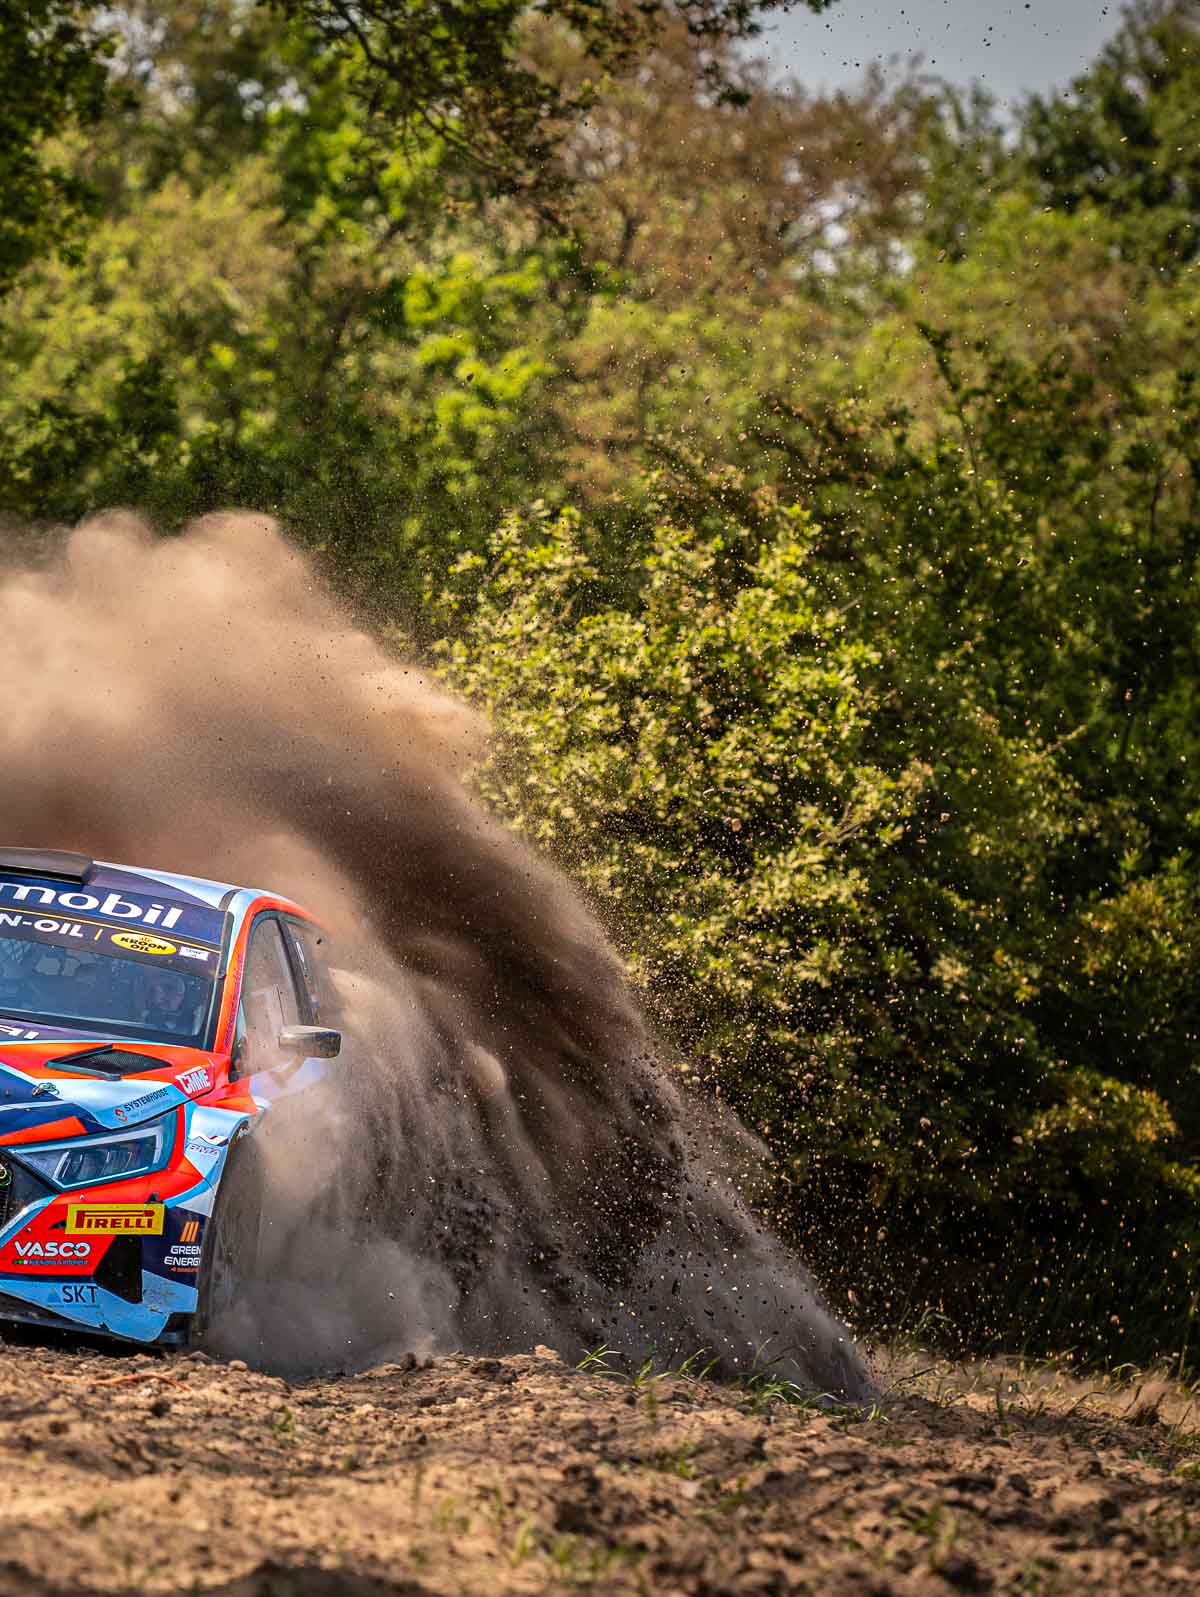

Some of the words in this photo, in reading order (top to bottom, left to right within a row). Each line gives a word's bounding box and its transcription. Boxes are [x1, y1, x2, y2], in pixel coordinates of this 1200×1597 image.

[120, 936, 168, 951] KROON
[130, 943, 151, 953] OIL
[74, 1209, 156, 1229] PIRELLI
[14, 1240, 91, 1258] VASCO
[163, 1256, 200, 1267] ENERG
[62, 1284, 98, 1304] SKT
